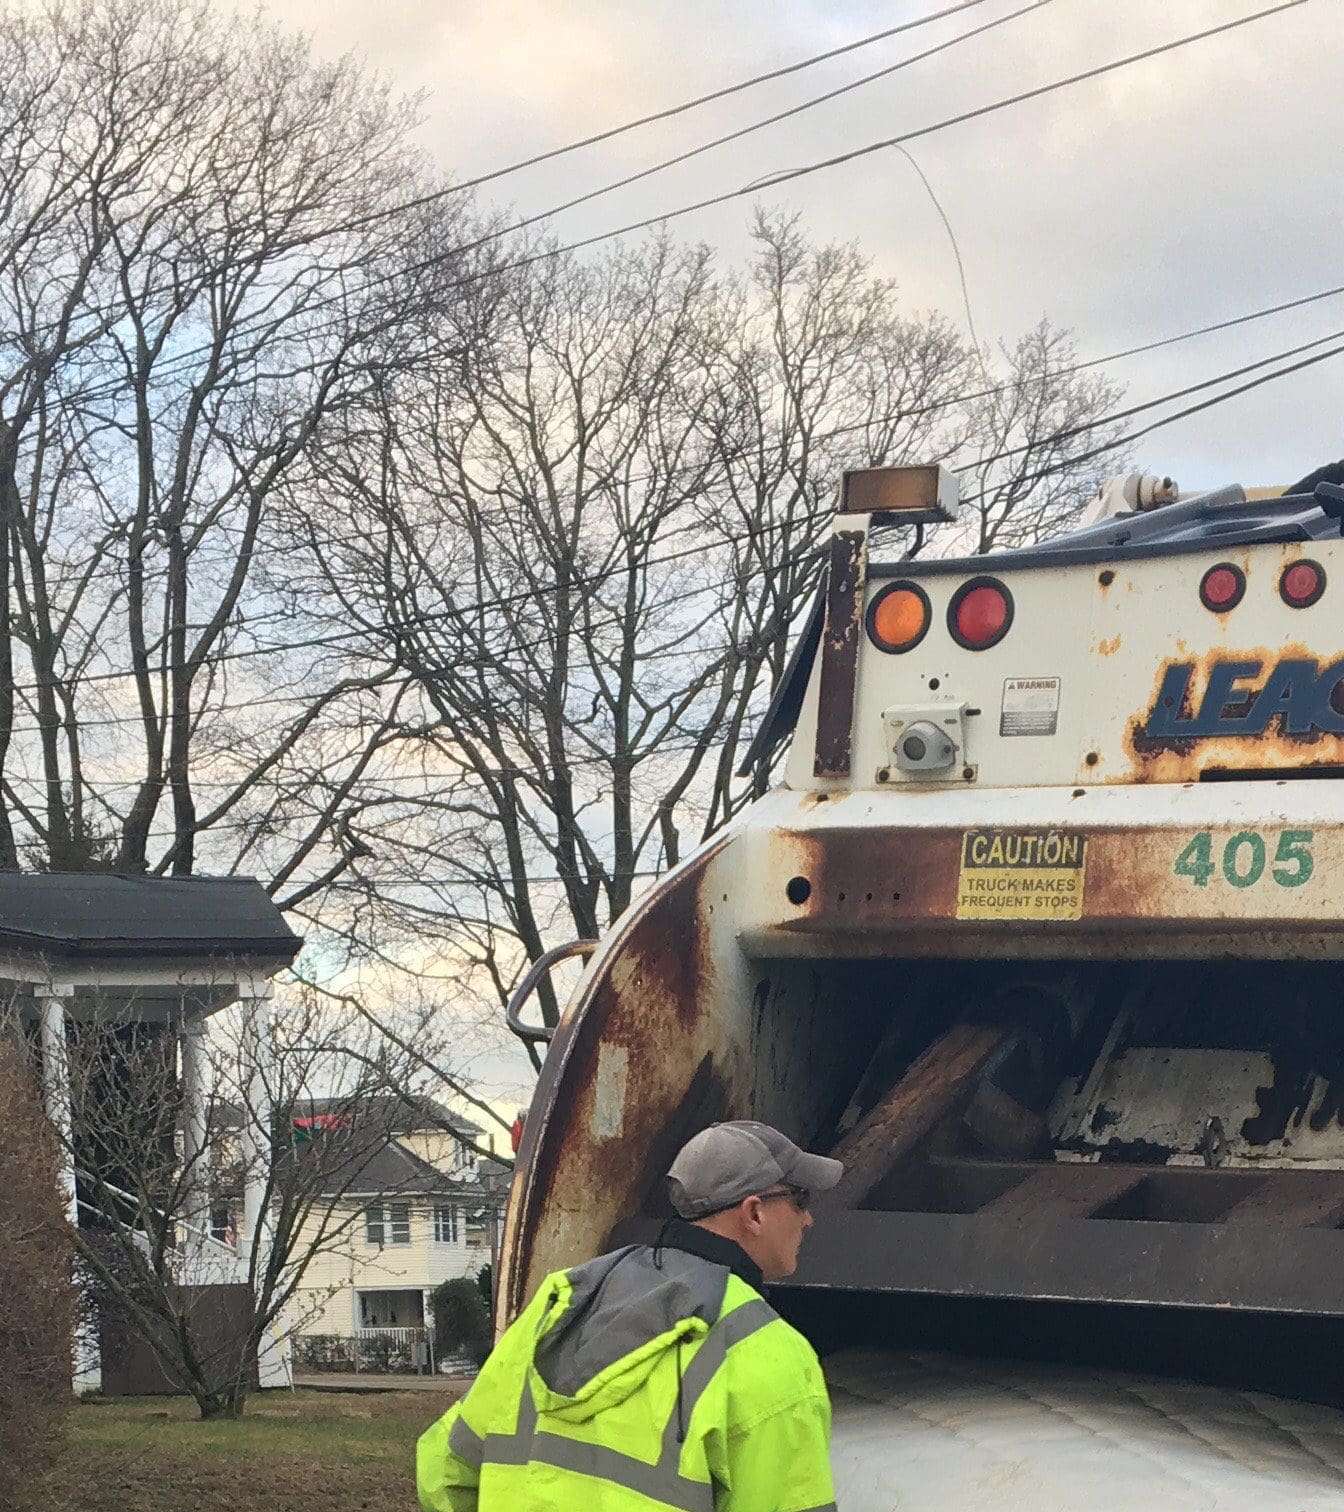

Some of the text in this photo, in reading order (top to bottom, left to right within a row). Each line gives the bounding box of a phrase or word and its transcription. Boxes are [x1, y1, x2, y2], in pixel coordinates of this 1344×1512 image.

[1016, 680, 1057, 690] WARNING
[971, 834, 1079, 865] CAUTION
[1173, 829, 1315, 889] 405
[967, 878, 1076, 892] TRUCK MAKES
[961, 895, 1078, 907] FREQUENT STOPS
